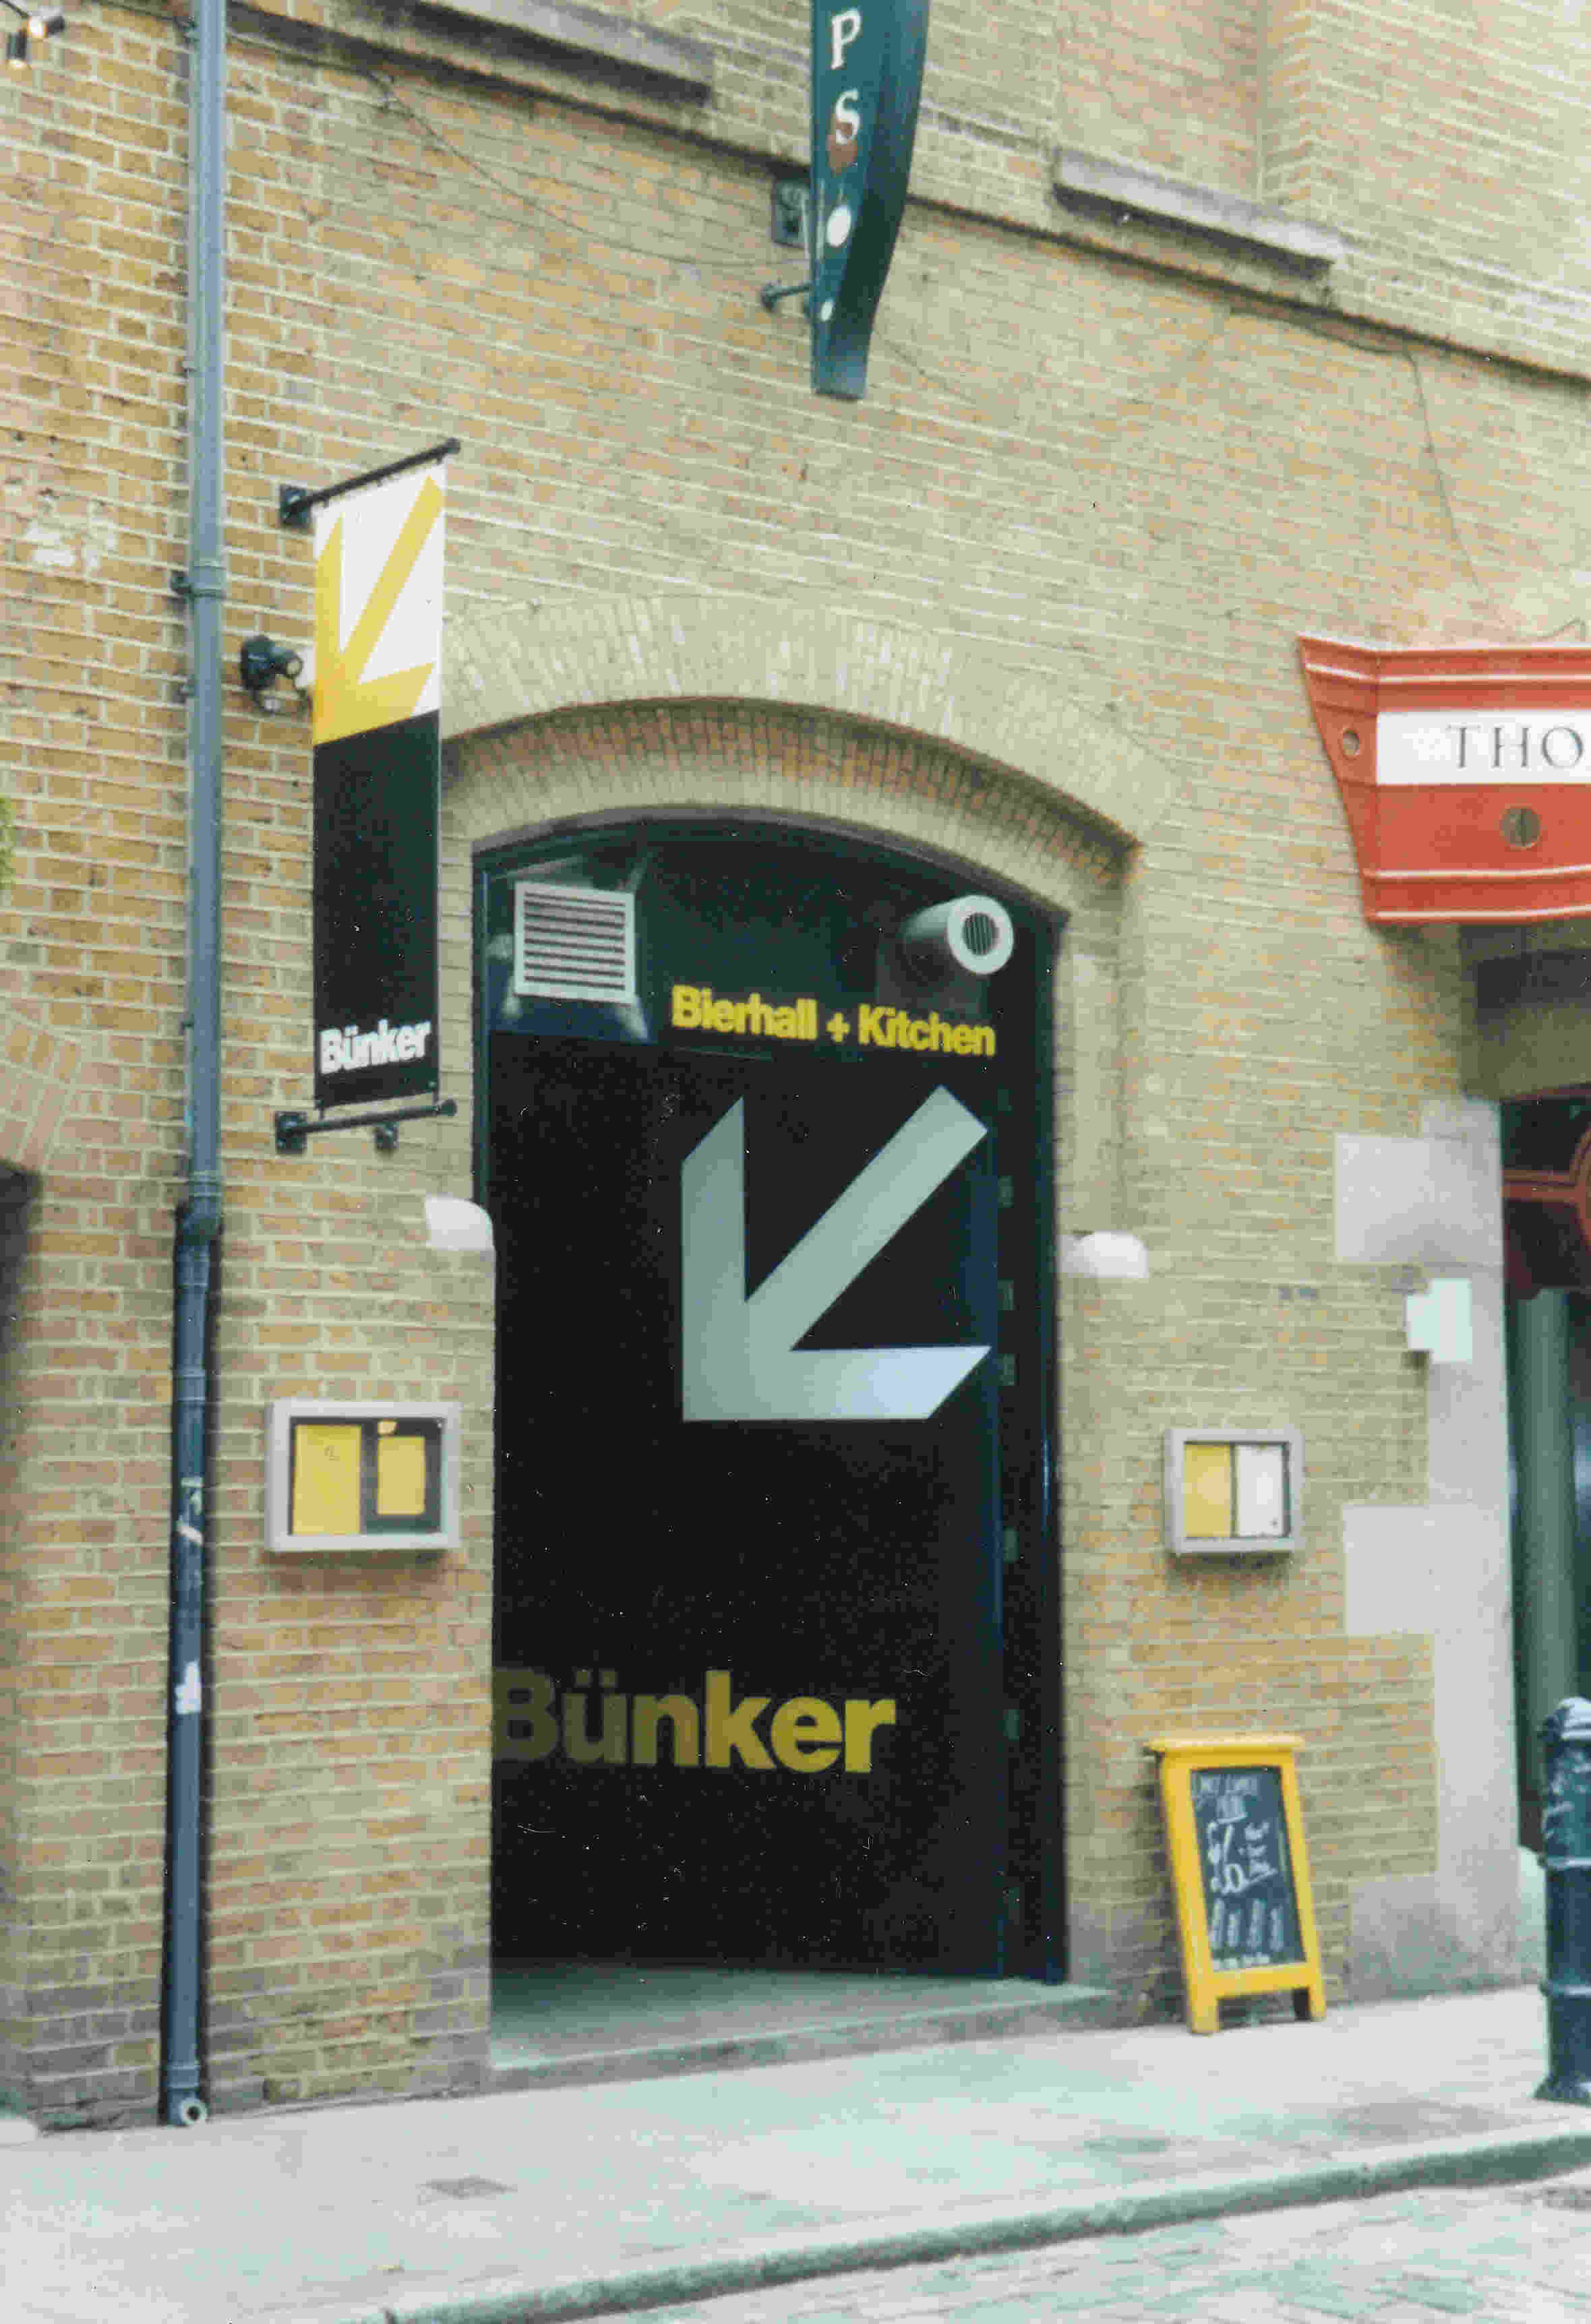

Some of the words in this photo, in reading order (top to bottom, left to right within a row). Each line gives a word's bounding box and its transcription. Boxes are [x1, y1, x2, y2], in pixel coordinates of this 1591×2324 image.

[1445, 724, 1584, 770] THO
[320, 1019, 431, 1074] Bünker
[671, 985, 818, 1040] Bierhall
[858, 1003, 996, 1056] Kitchen
[492, 1669, 897, 1773] Bünker
